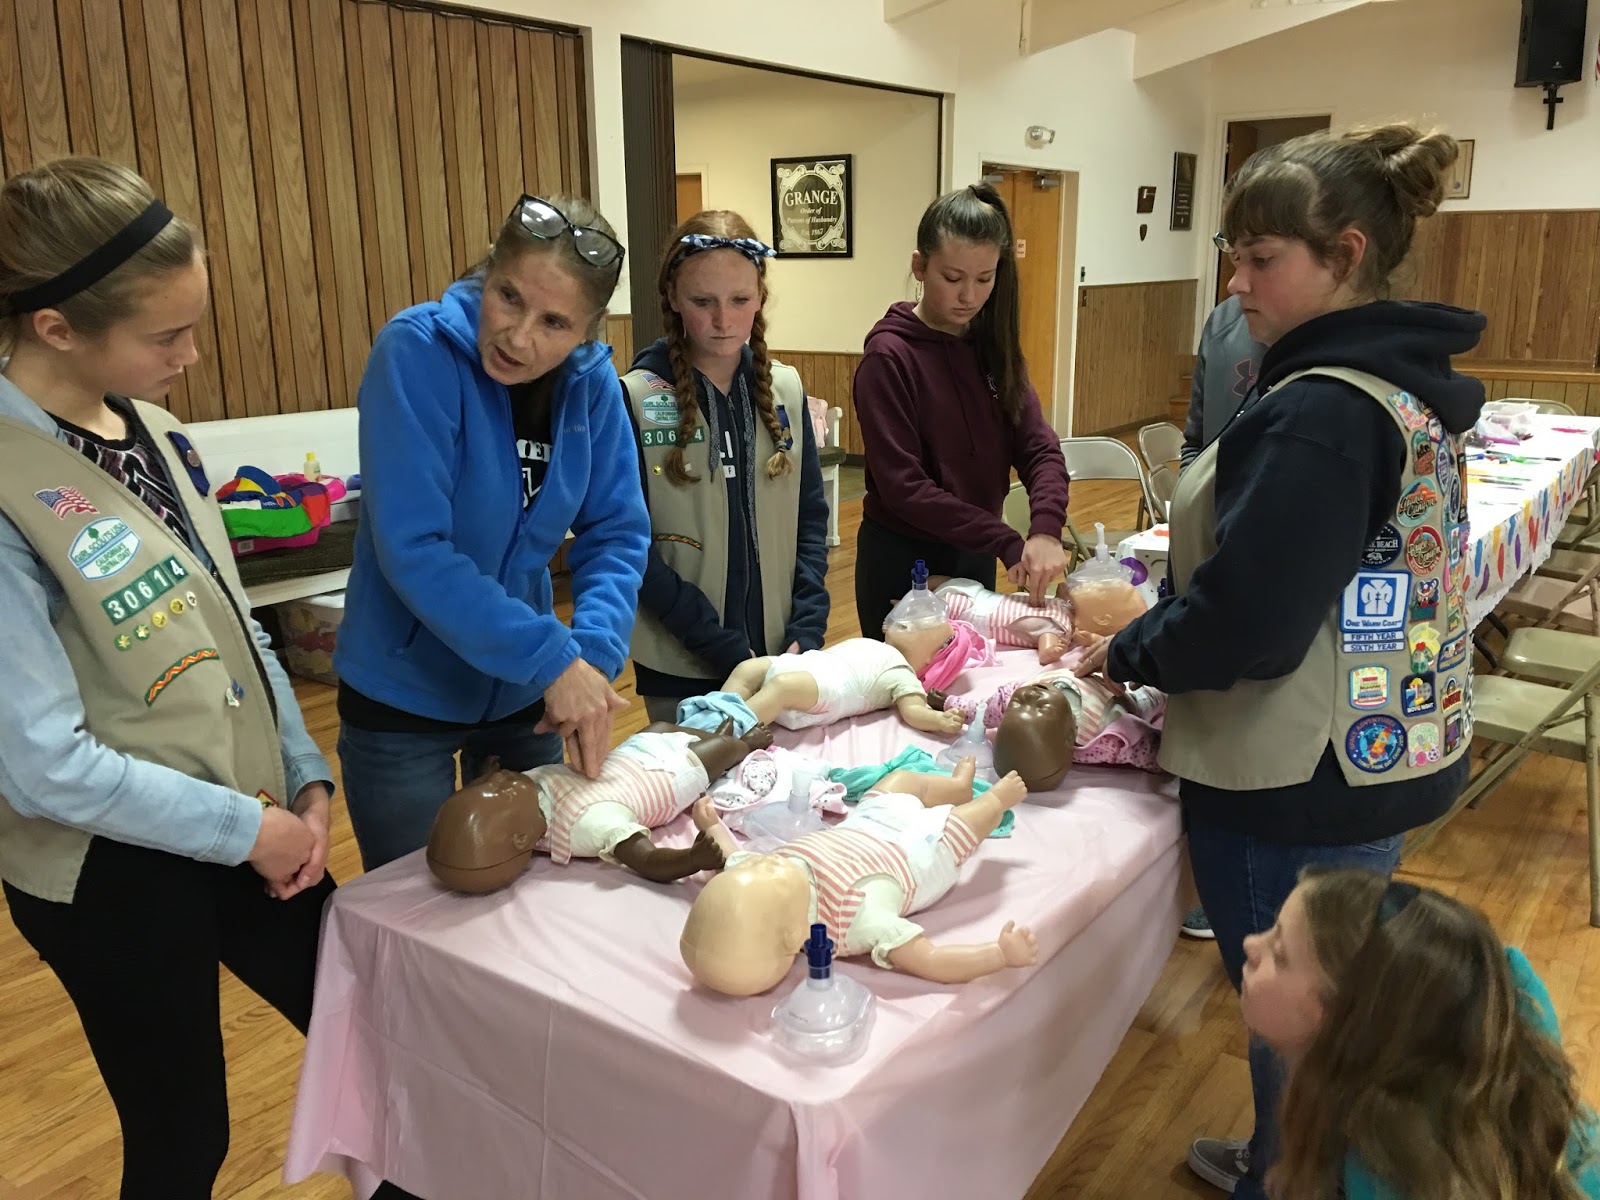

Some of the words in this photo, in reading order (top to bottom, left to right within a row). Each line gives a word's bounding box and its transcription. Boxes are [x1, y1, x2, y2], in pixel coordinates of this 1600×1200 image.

[785, 190, 838, 206] GRANGE
[74, 549, 92, 564] GIRL
[88, 530, 114, 550] SCOUTS
[110, 523, 125, 536] USA
[1376, 539, 1399, 548] BEACH
[108, 560, 184, 619] 30614
